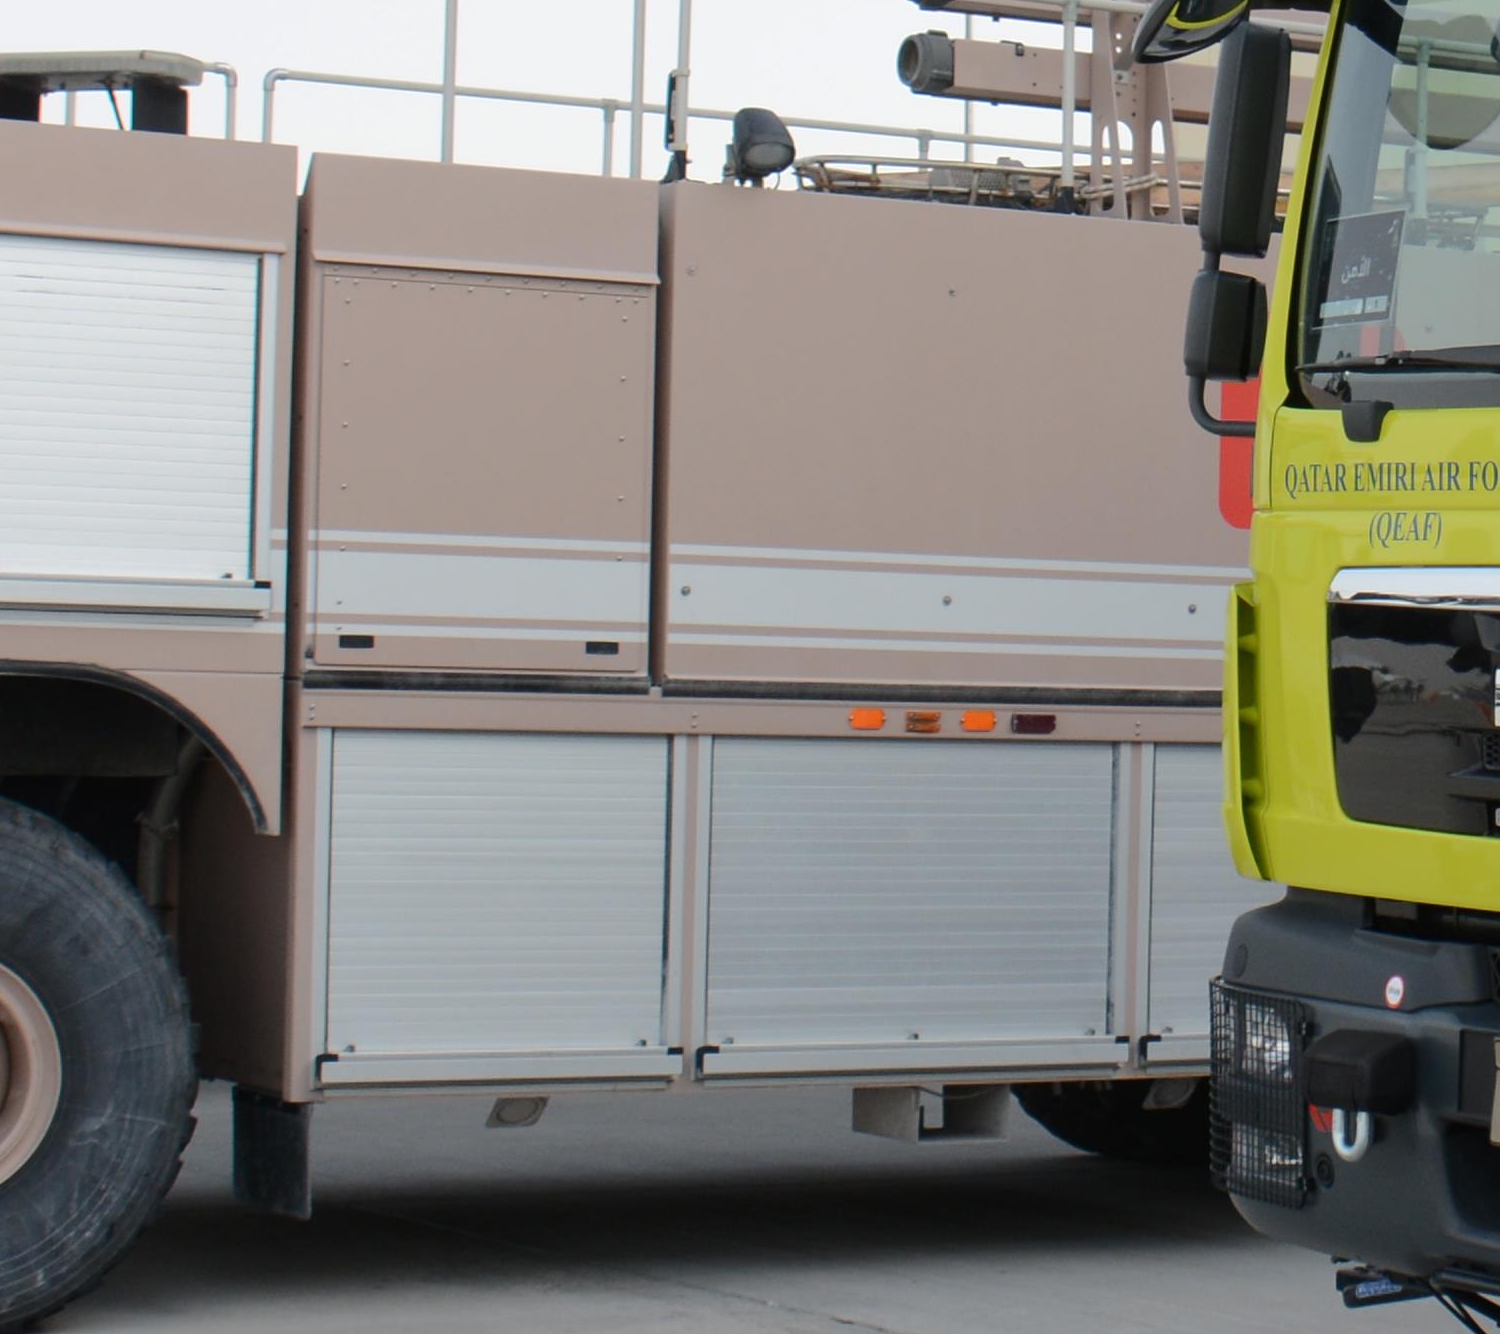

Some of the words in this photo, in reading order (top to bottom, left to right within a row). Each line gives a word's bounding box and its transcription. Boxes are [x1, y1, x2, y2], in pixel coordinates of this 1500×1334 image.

[1285, 463, 1347, 499] QATAR
[1353, 461, 1416, 492] EMIRI
[1421, 461, 1461, 492] AIR
[1369, 512, 1442, 549] (QEAF)
